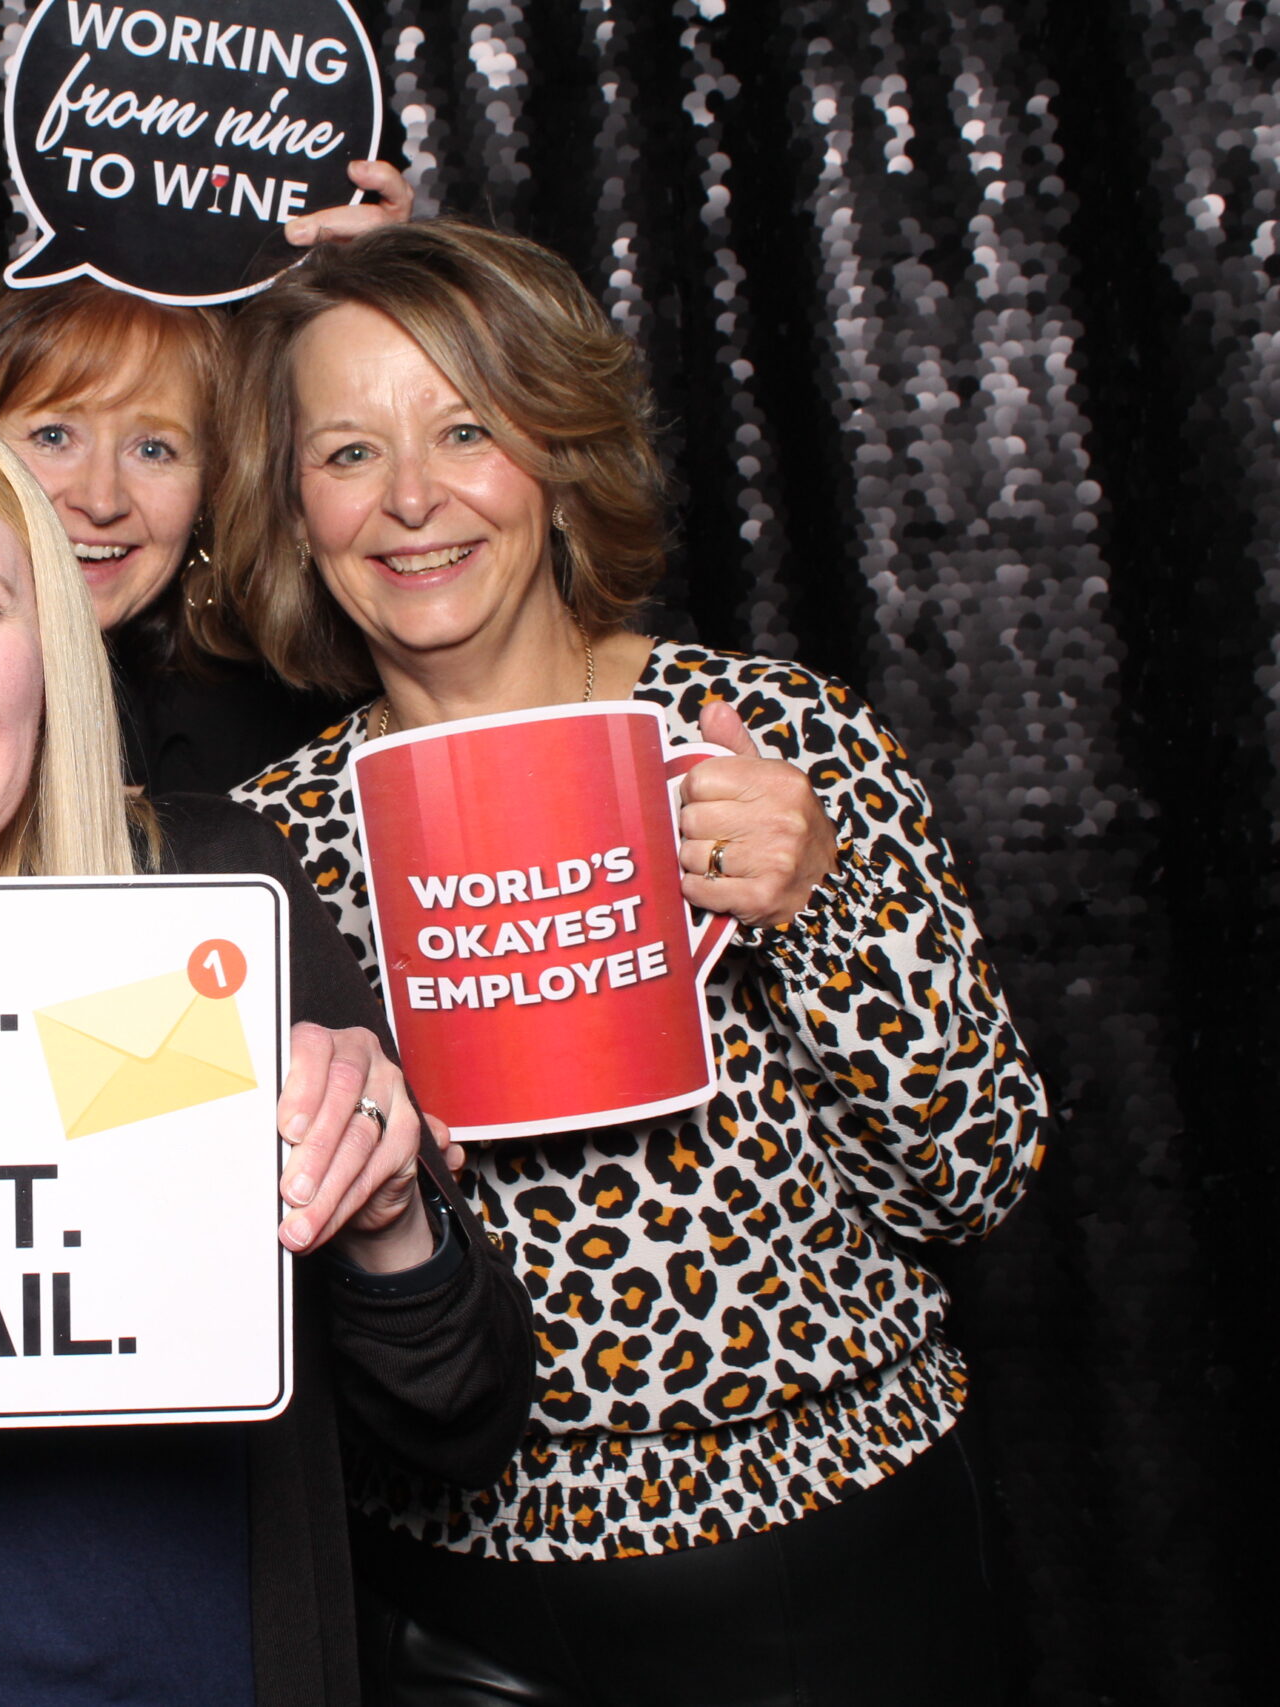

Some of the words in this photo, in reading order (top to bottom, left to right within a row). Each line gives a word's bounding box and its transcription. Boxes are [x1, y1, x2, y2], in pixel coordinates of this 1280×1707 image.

[67, 0, 348, 84] WORKING
[35, 52, 209, 152] from
[214, 87, 345, 160] nine
[62, 147, 135, 199] TO
[153, 160, 309, 224] WINE
[407, 846, 635, 909] WORLD'S
[417, 895, 642, 960] OKAYEST
[202, 949, 228, 988] 1
[406, 941, 668, 1011] EMPLOYEE
